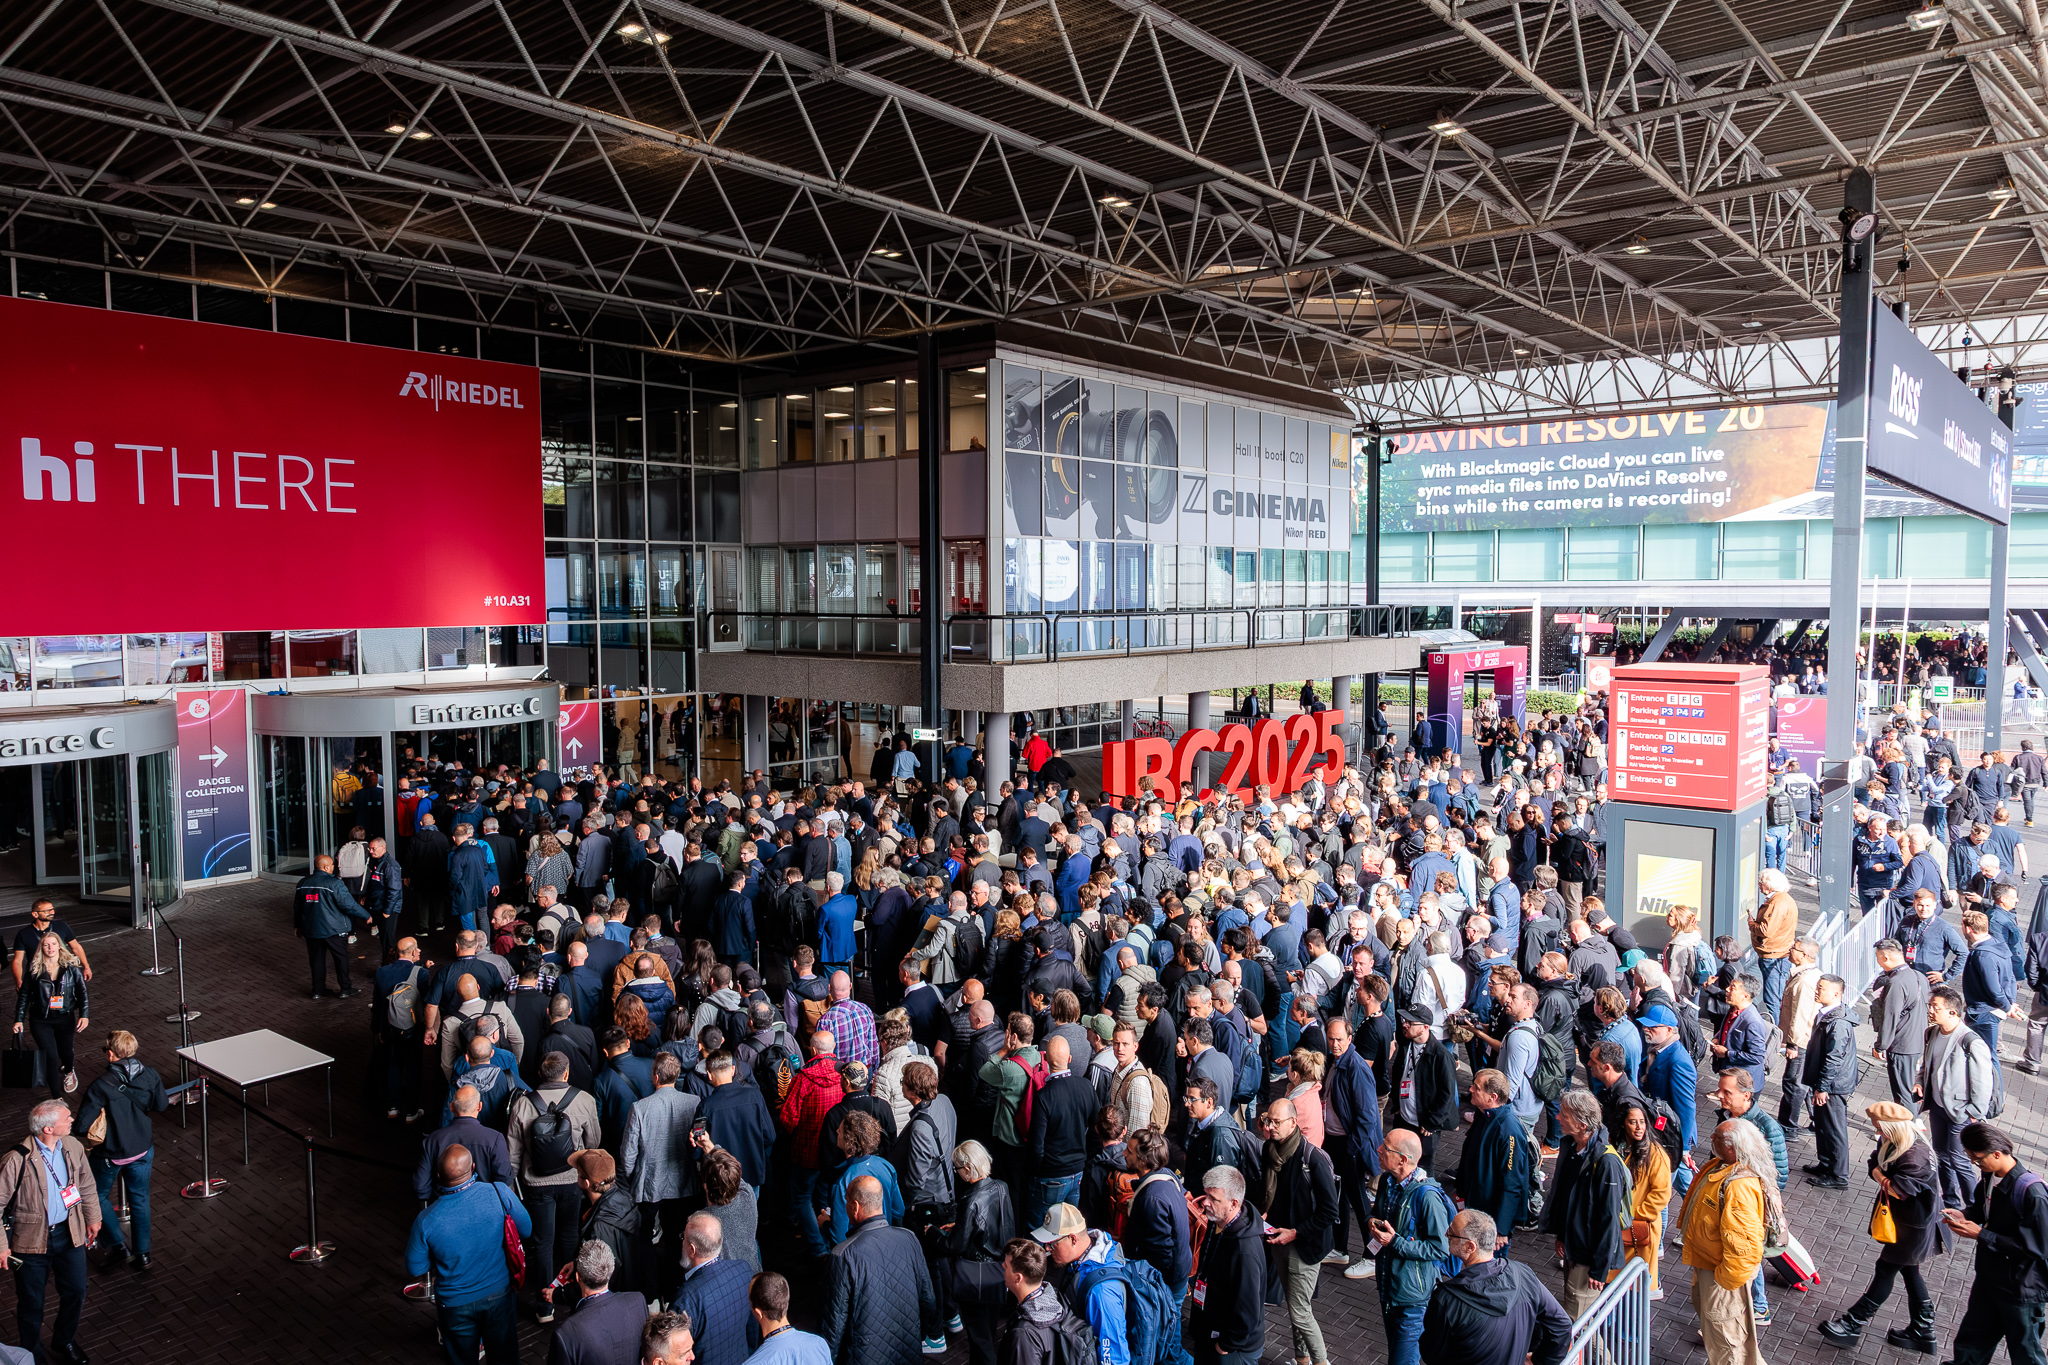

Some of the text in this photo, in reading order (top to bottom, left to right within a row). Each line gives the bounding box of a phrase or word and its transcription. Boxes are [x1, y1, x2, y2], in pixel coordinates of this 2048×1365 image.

[446, 380, 524, 409] RIEDEL
[1889, 364, 1920, 426] ROSS
[1394, 405, 1764, 454] DAVINCI RESOLVE 20
[1236, 443, 1251, 457] Hall
[1290, 451, 1304, 464] C20
[1332, 458, 1348, 469] Nikon
[1421, 446, 1724, 478] With Blackmagic Cloud you can live
[21, 437, 357, 514] hi THERE
[1418, 467, 1728, 500] sync media files into DaVinci Resolve
[1212, 490, 1326, 523] CINEMA
[1416, 487, 1731, 516] bins while the camera is recording!
[1285, 527, 1326, 539] Nikon RED
[484, 596, 530, 606] #10.A31
[1631, 694, 1664, 702] Entrance
[414, 697, 540, 724] Entrance C
[1630, 707, 1659, 715] Parking
[1692, 709, 1704, 717] P7
[0, 727, 115, 757] ance C
[1630, 732, 1663, 740] Entrance
[1630, 744, 1658, 753] Parking
[1103, 709, 1345, 815] IBC2025
[198, 776, 231, 786] BADGE
[1630, 775, 1662, 783] Entrance
[186, 785, 244, 797] COLLECTION
[1640, 897, 1698, 914] Nikn
